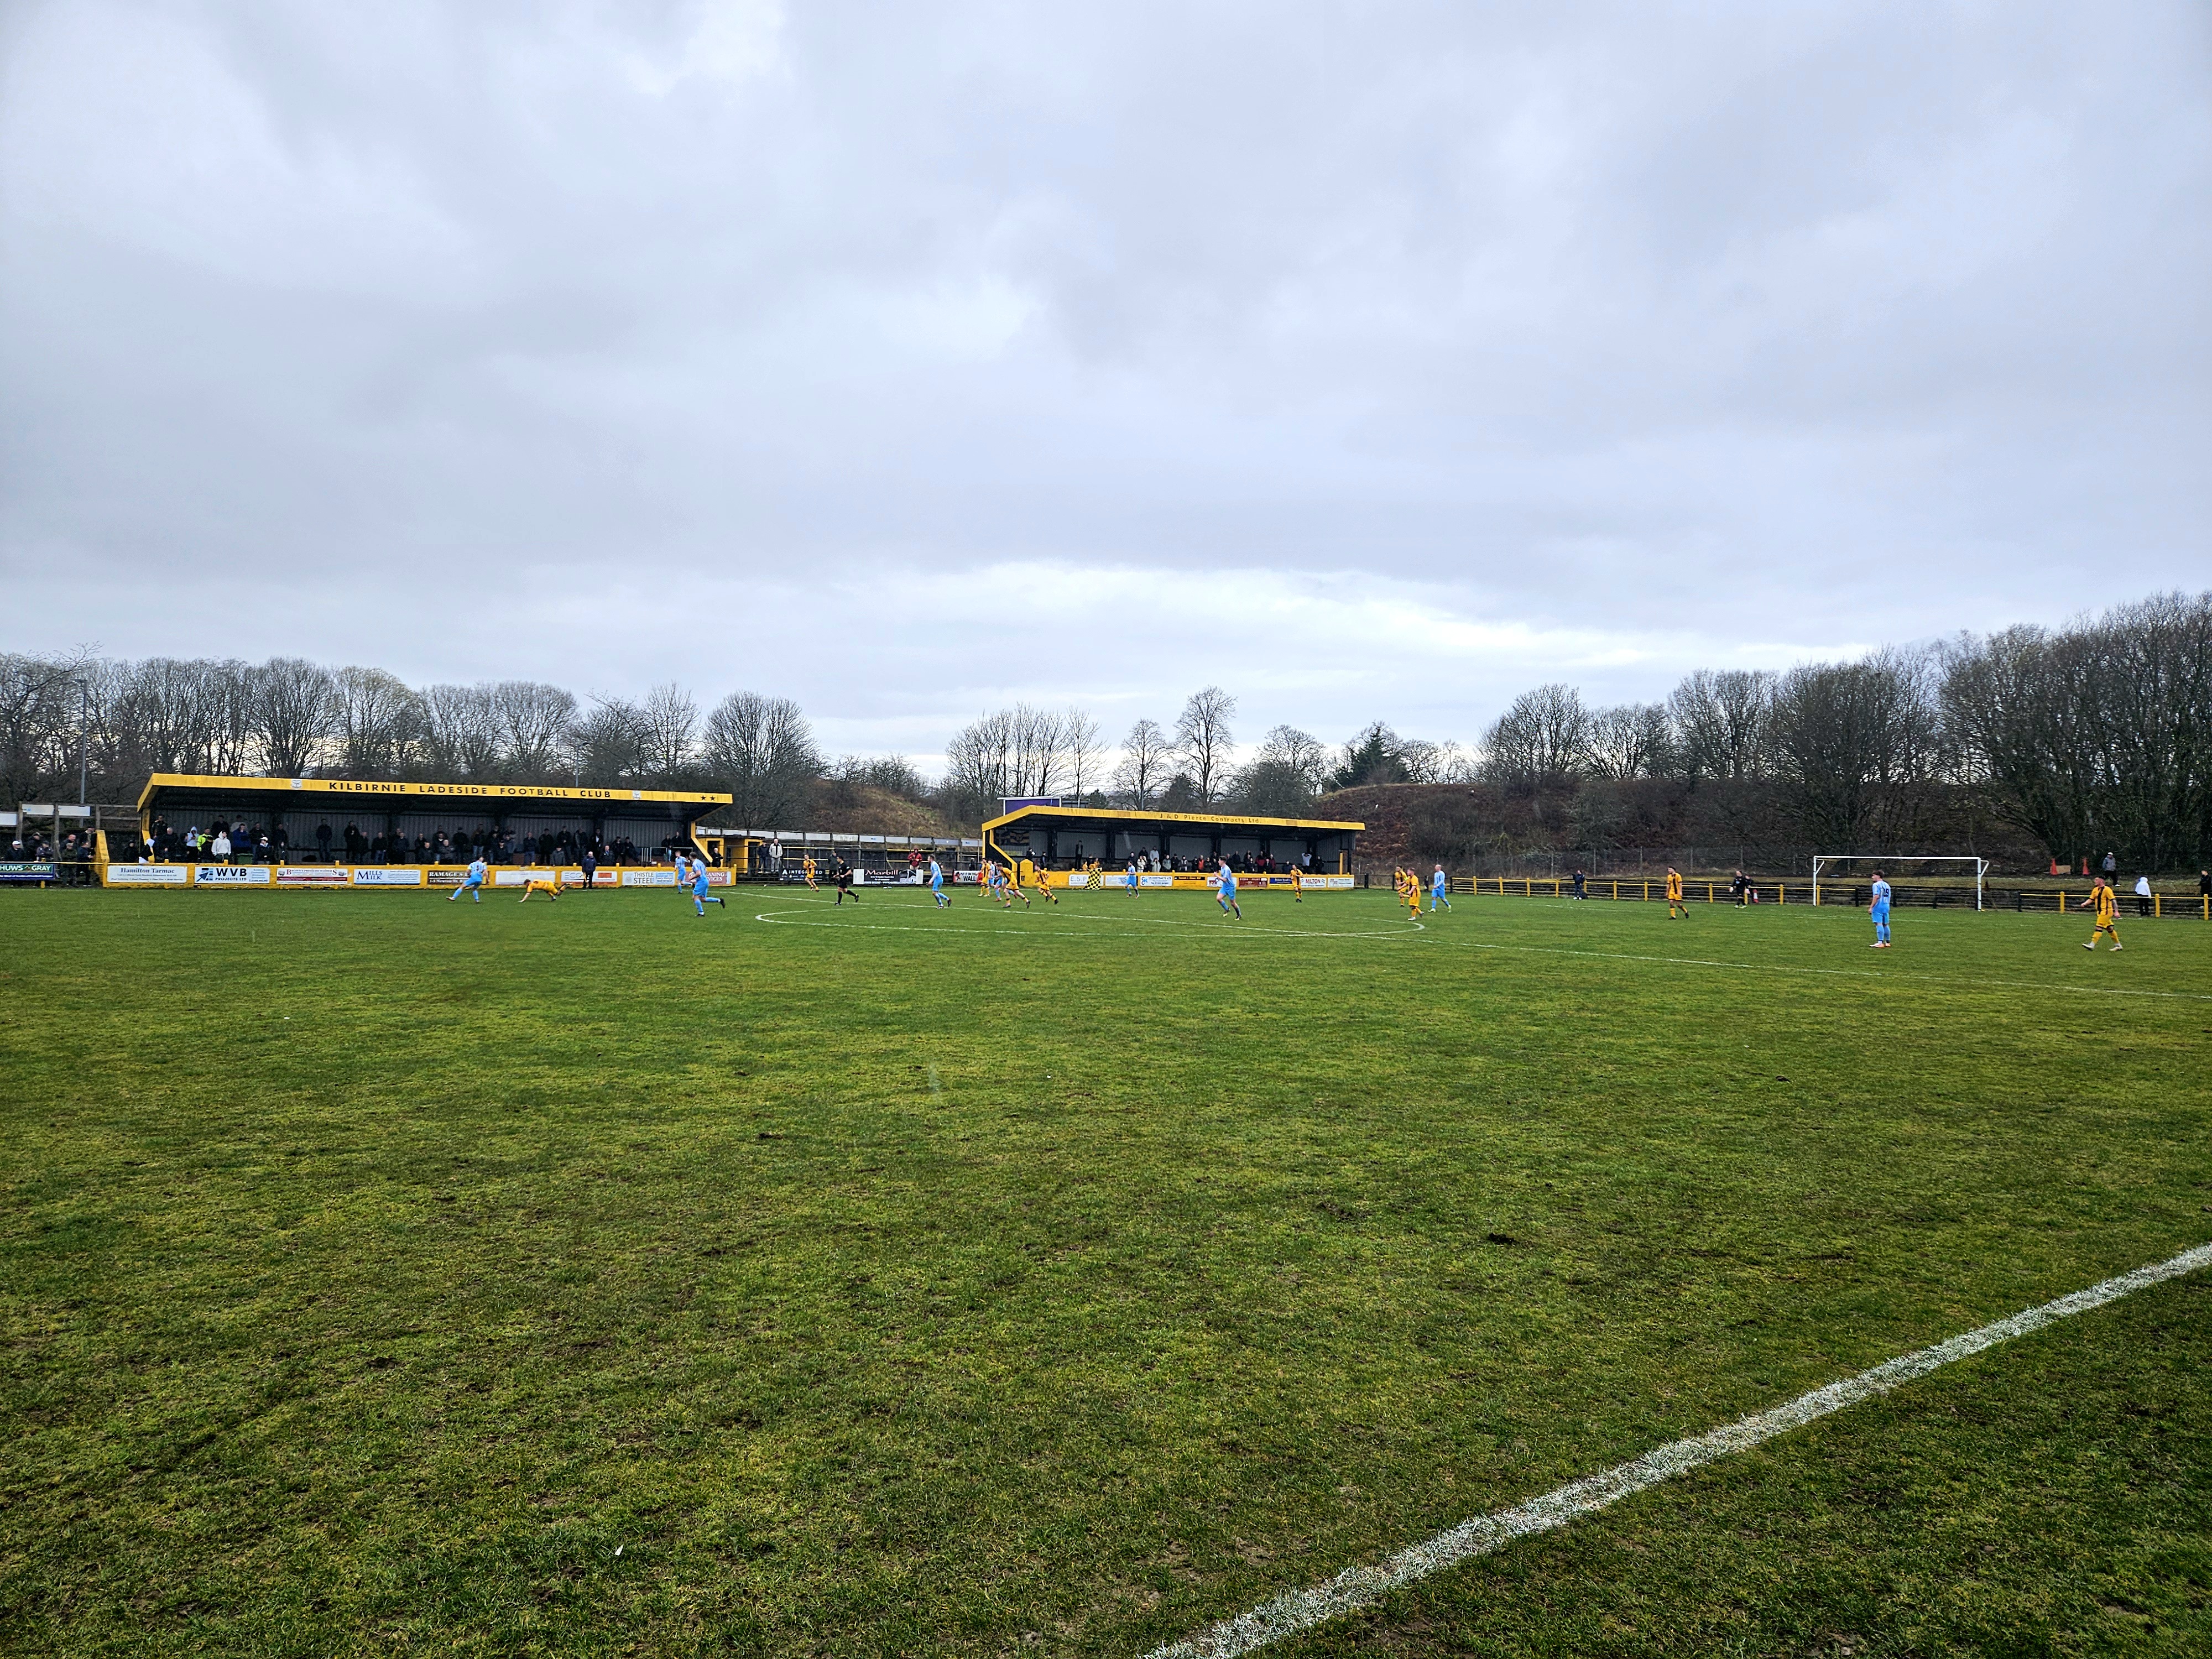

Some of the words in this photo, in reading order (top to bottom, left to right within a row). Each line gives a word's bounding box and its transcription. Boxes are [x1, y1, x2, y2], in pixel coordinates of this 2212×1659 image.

[329, 782, 405, 792] KILBIRNIE
[419, 785, 487, 794] LADESIDE
[500, 787, 568, 796] FOOTBALL
[216, 868, 247, 877] WVB
[357, 870, 383, 879] MILLS
